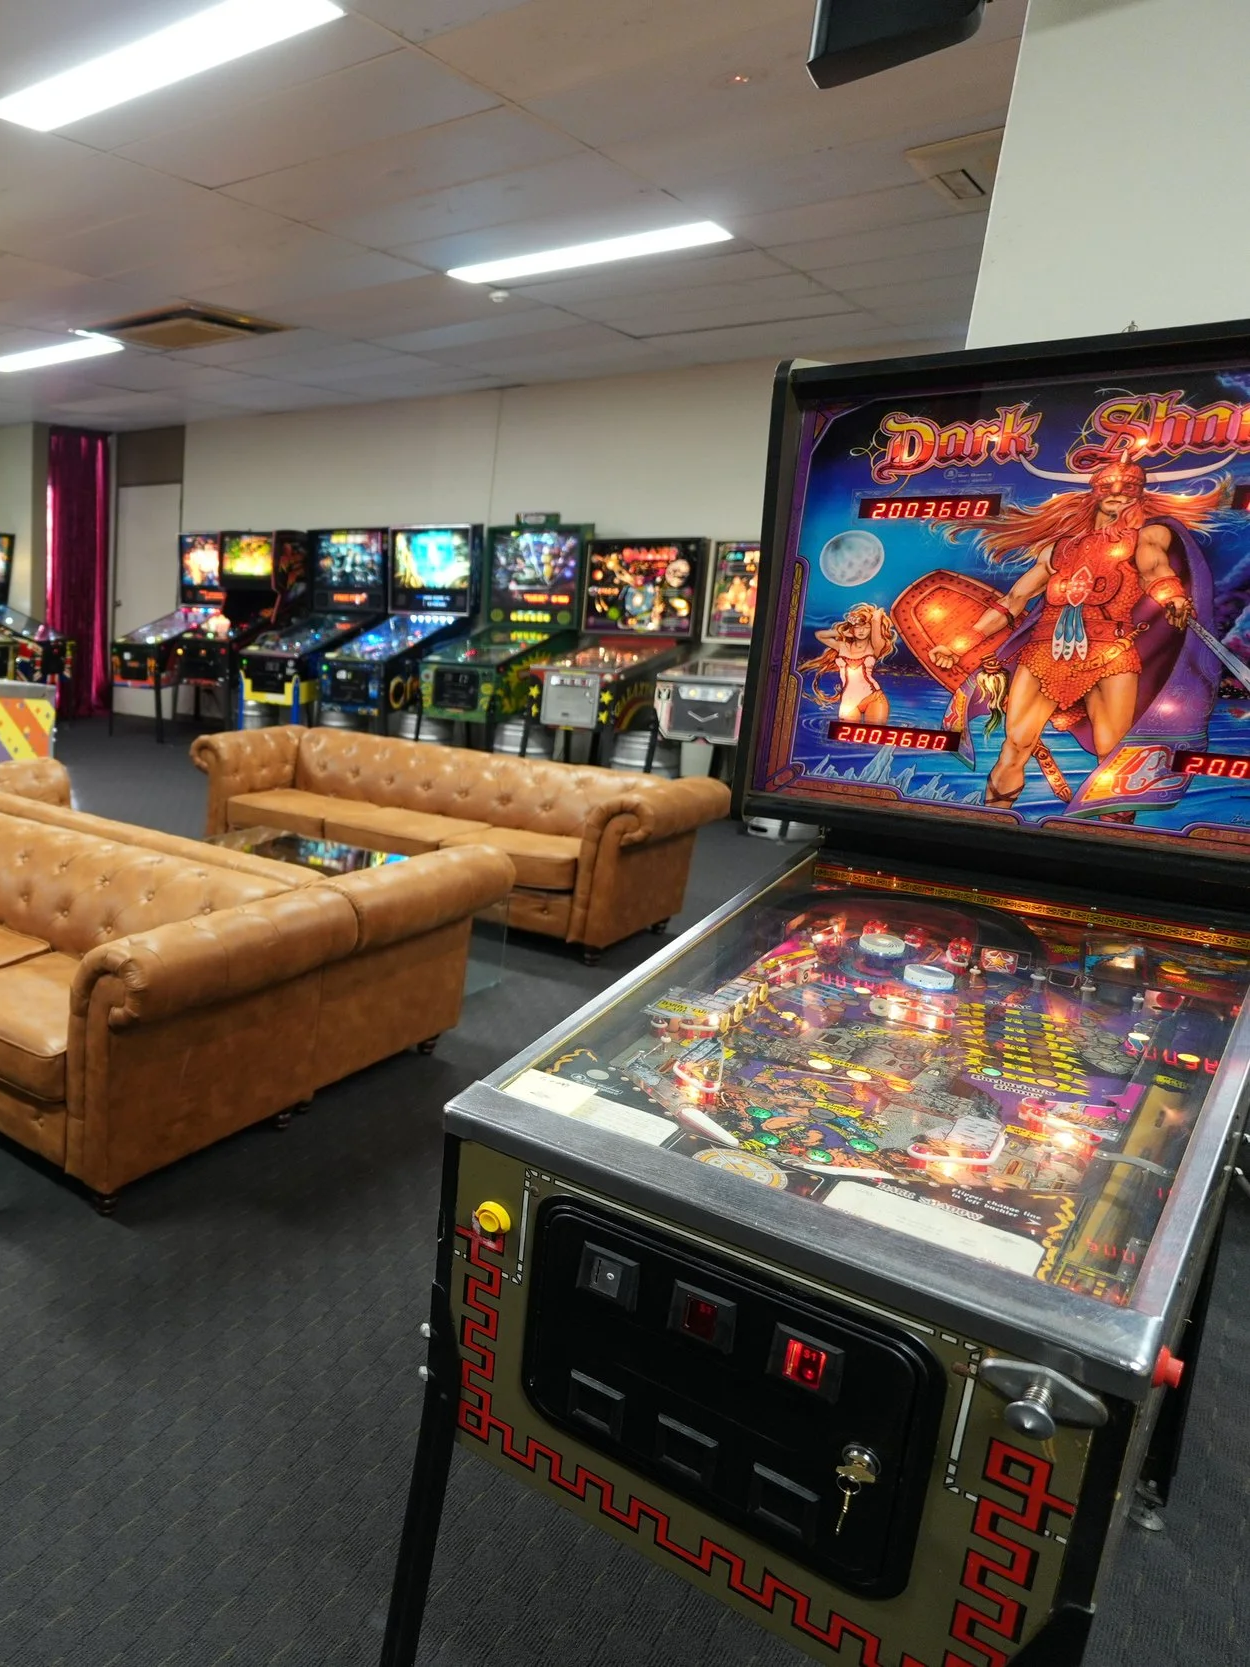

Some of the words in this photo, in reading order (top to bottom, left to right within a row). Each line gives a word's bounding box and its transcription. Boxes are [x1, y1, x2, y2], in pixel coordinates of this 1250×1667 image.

[871, 403, 1042, 484] Dark
[951, 1191, 962, 1200] in
[951, 1187, 983, 1204] Flipper
[986, 1199, 1021, 1216] change
